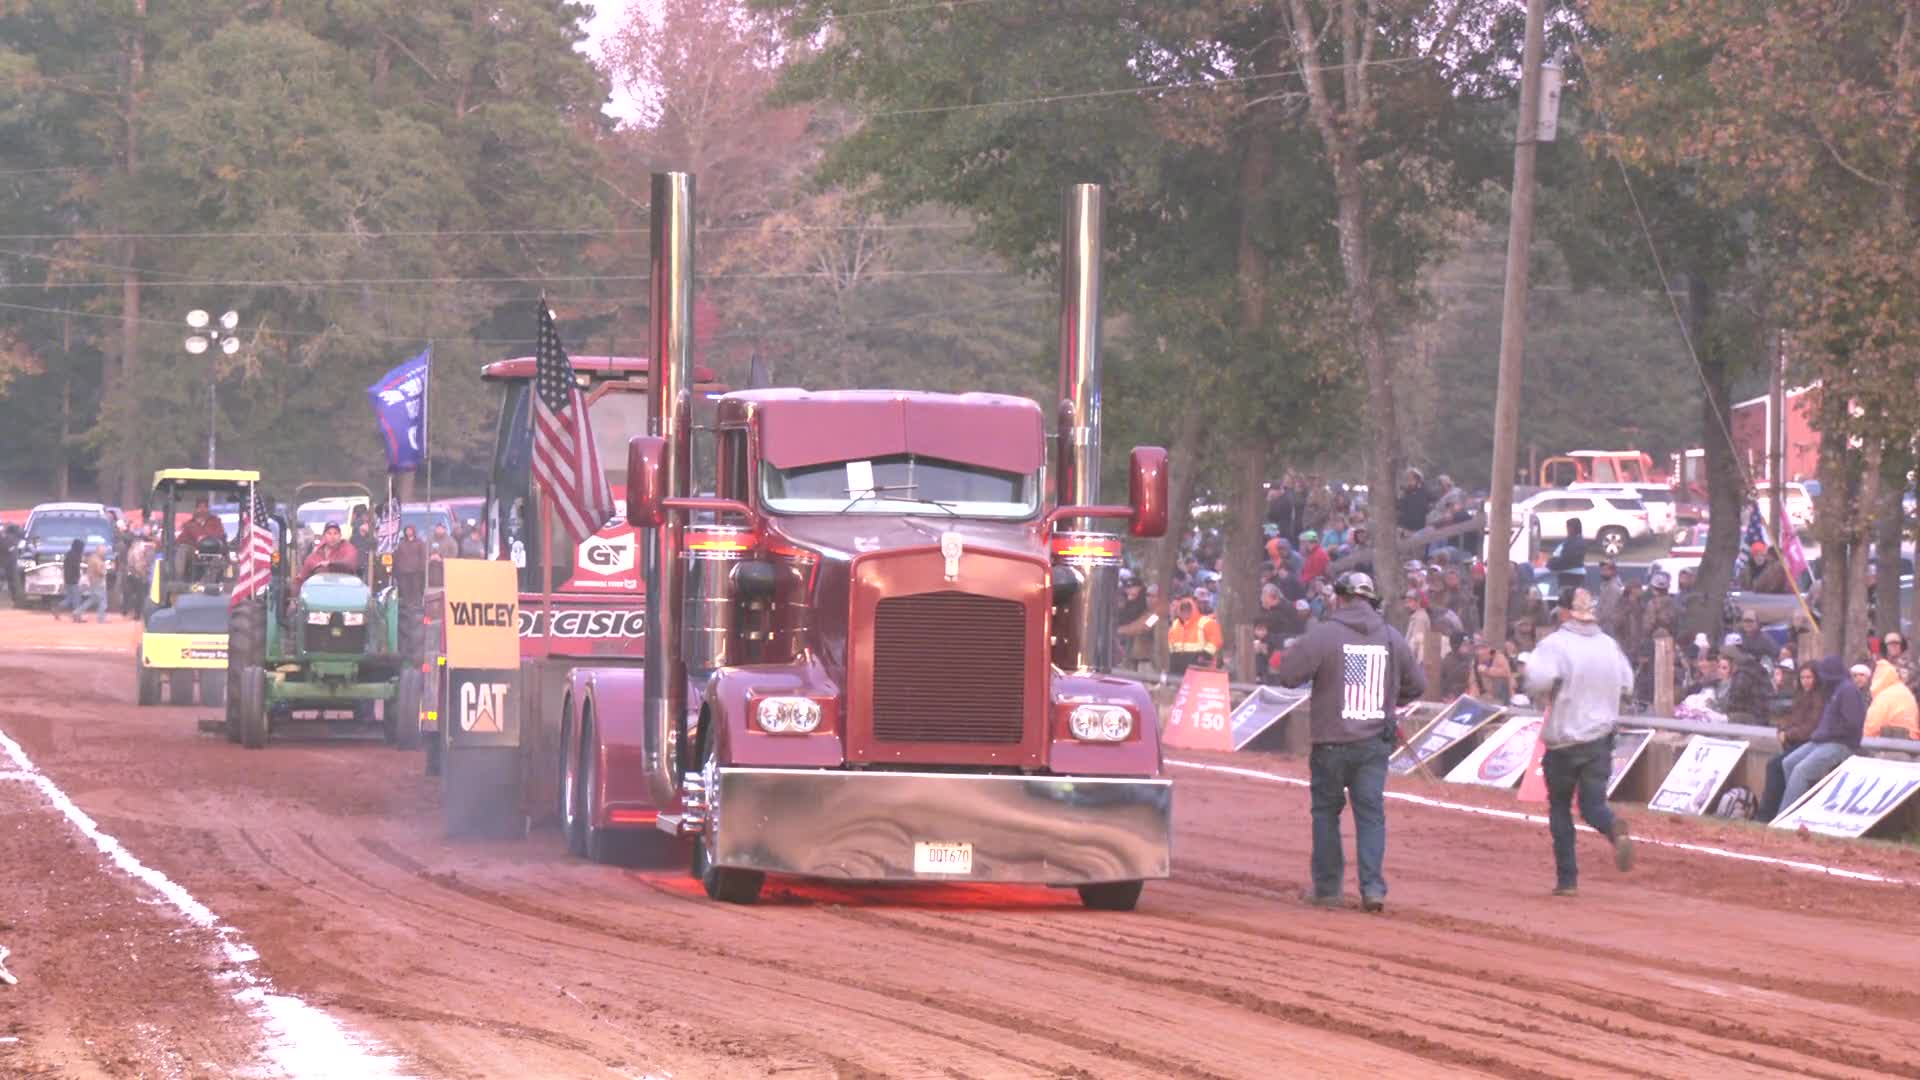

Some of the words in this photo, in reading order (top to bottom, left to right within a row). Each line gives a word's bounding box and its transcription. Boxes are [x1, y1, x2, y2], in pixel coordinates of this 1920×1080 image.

[449, 601, 516, 627] YANCEY
[460, 681, 508, 733] CAT
[1191, 711, 1225, 731] 150
